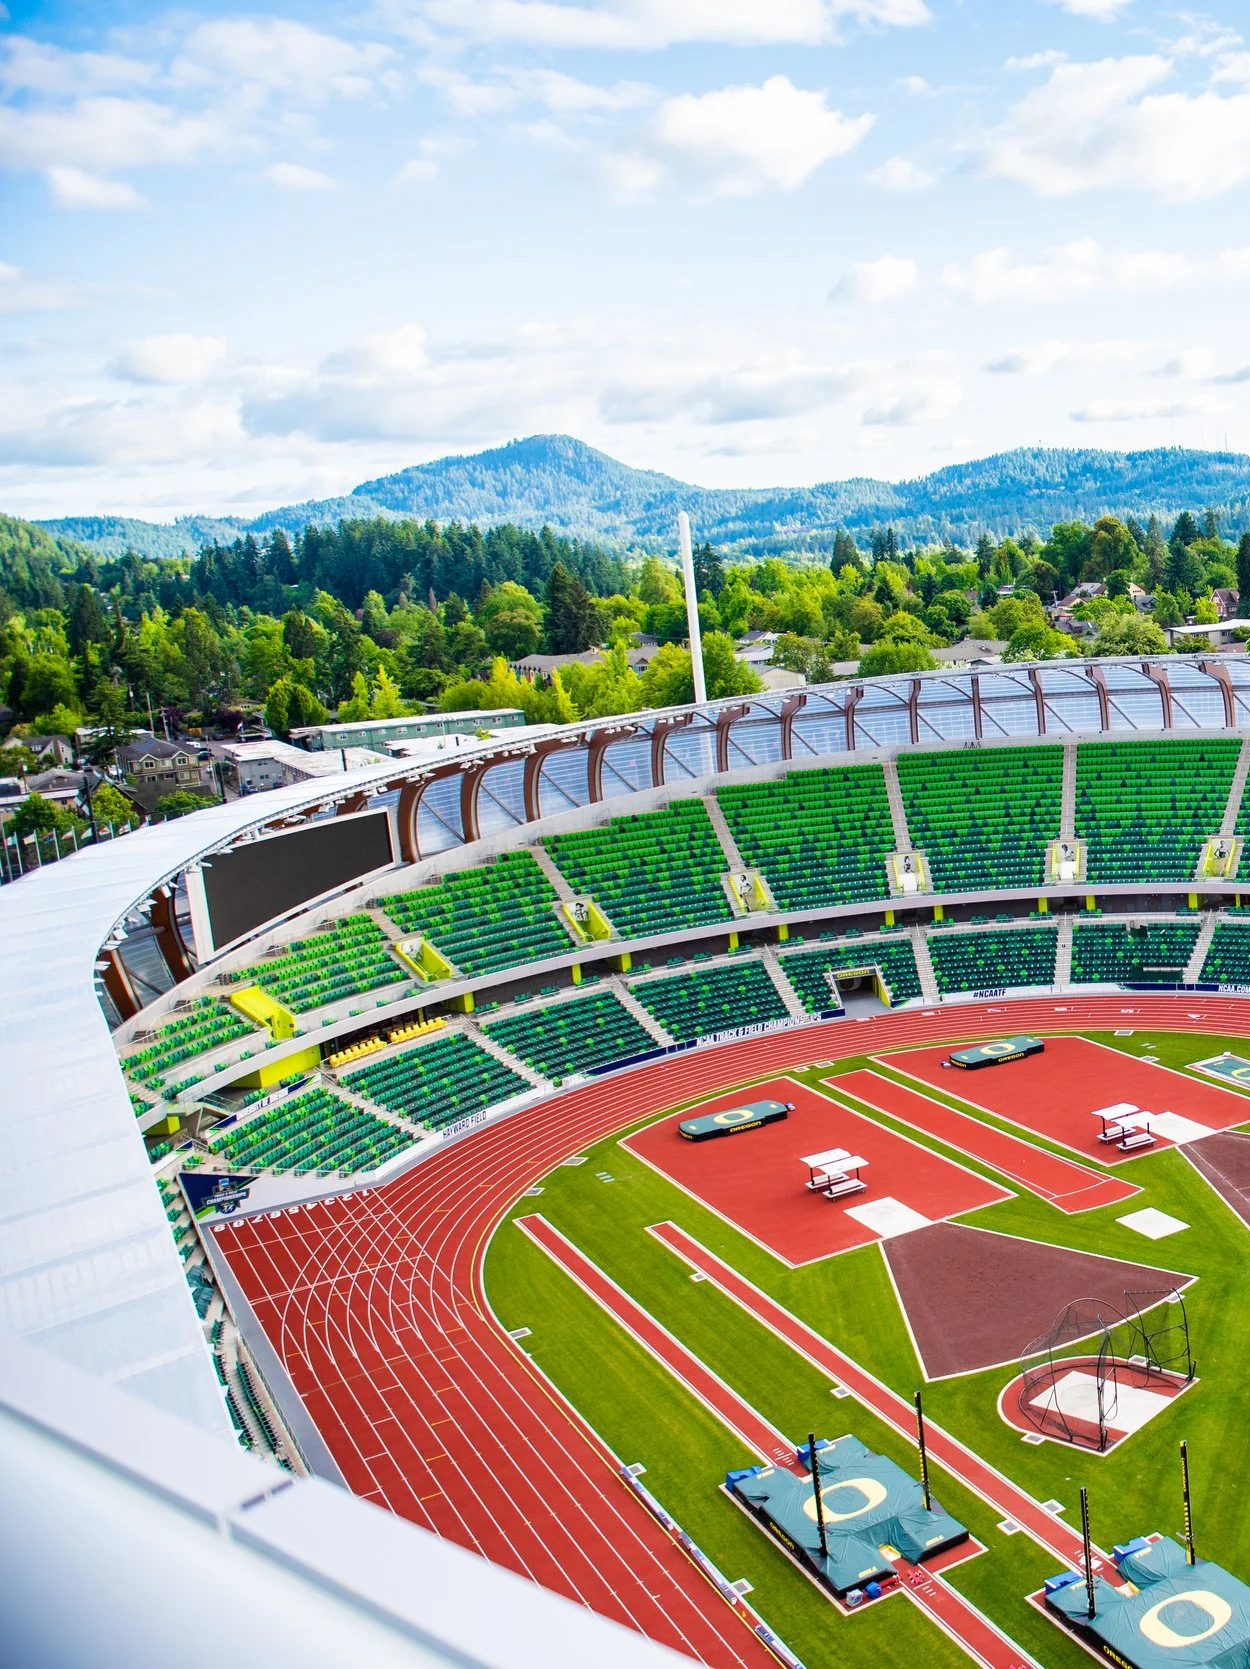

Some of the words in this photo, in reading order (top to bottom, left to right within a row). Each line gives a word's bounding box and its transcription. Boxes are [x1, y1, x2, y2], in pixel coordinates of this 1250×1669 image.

[973, 989, 1006, 998] #NCAATF
[1218, 984, 1250, 993] NCAA.COM
[696, 1035, 714, 1047] NCAA
[716, 1030, 736, 1042] TRACK
[745, 1023, 762, 1035] FIELD
[764, 1012, 821, 1030] CHAMPIONSIPS
[443, 1119, 470, 1138] HAYWARD
[471, 1110, 487, 1127] FIELD
[729, 1121, 762, 1132] OREGON
